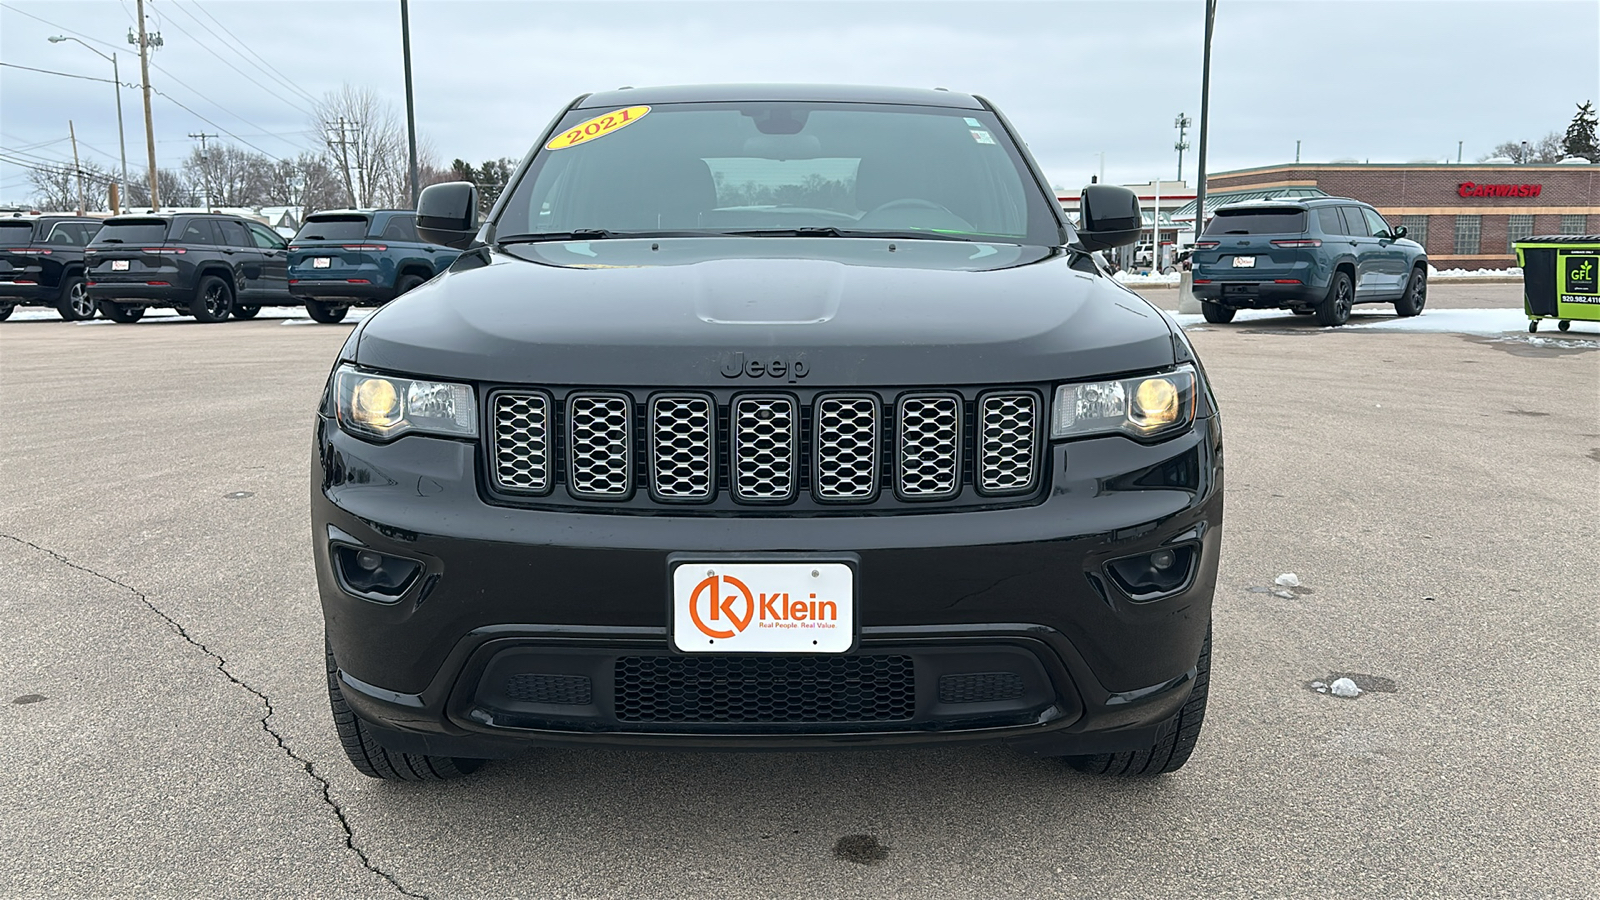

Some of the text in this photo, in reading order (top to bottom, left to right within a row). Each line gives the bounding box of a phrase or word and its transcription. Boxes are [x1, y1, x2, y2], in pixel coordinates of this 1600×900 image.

[567, 110, 633, 144] 2021
[1459, 181, 1542, 198] CARWASH
[1571, 266, 1592, 280] GFL
[720, 351, 811, 384] Jeep
[759, 593, 837, 621] Klein
